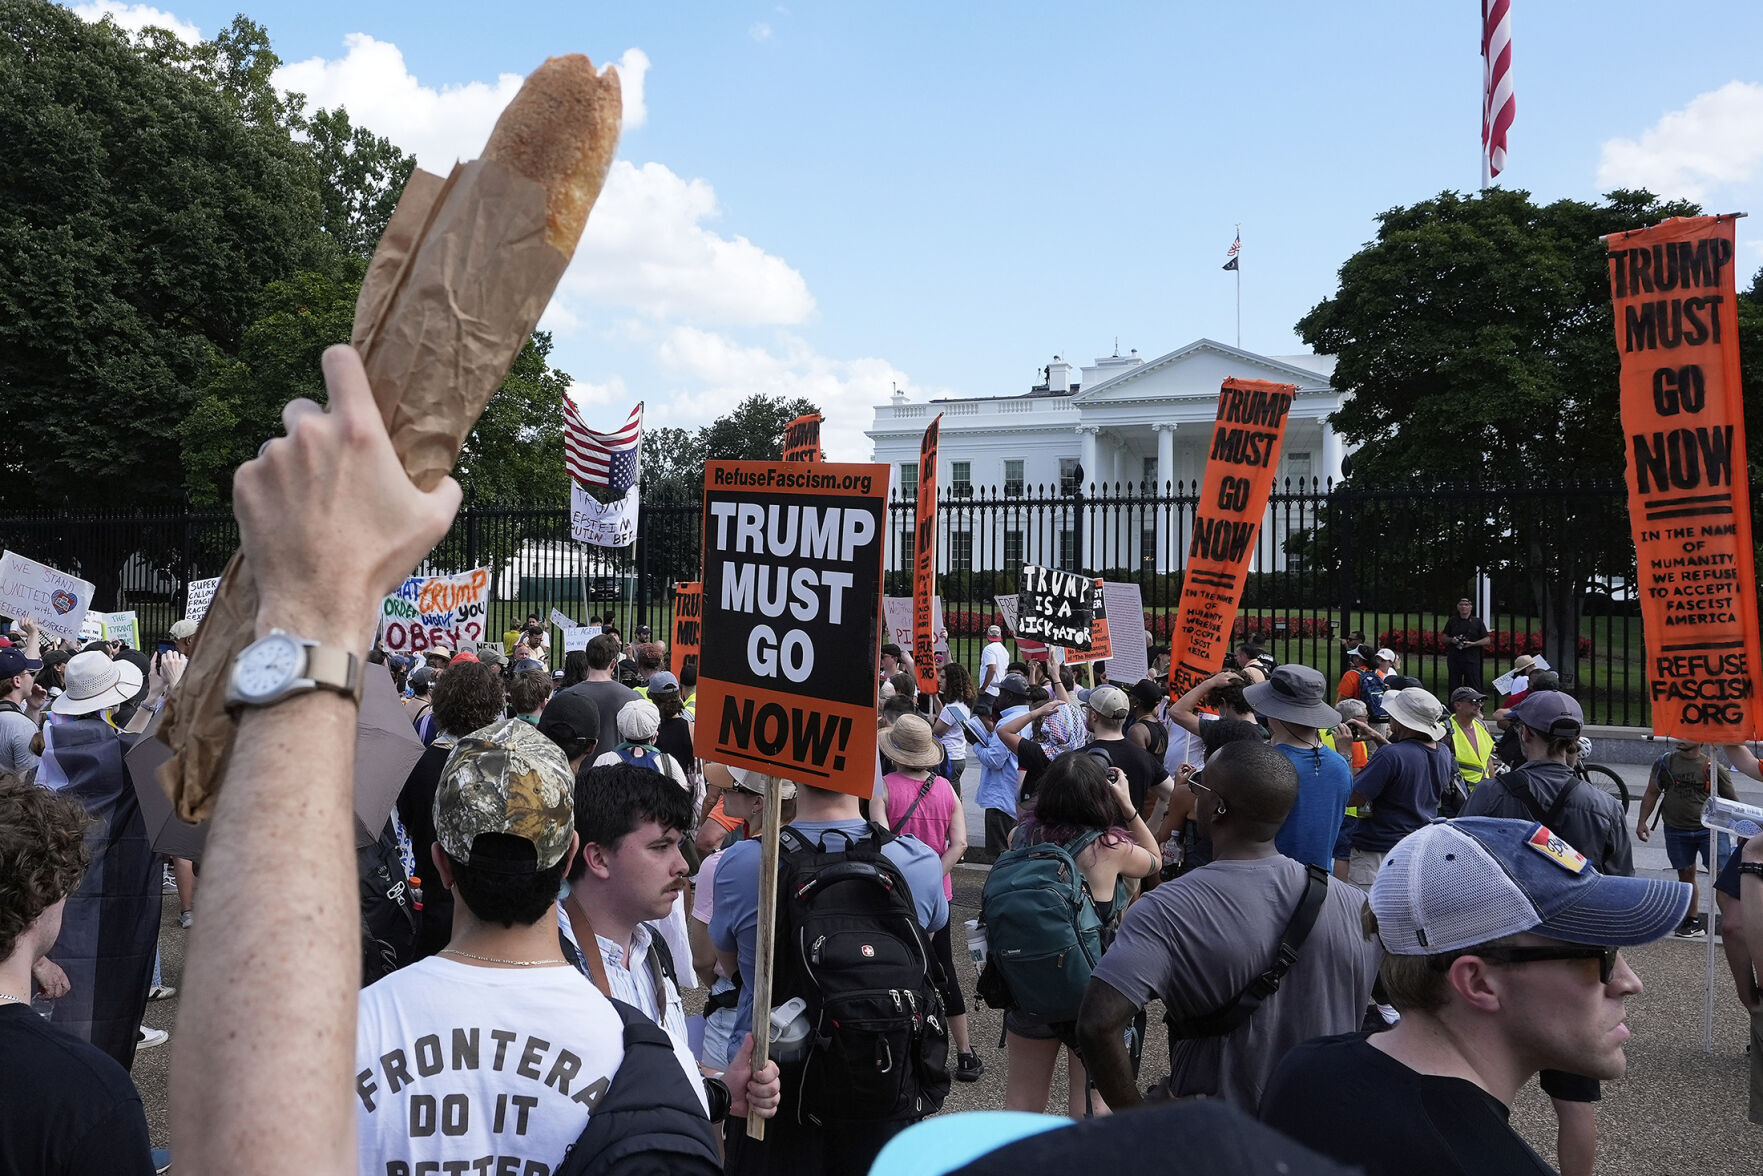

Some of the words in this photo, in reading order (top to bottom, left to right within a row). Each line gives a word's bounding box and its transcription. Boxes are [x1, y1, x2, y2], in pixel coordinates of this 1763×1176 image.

[1609, 237, 1732, 298] TRUMP
[1625, 295, 1723, 353] MUST
[1653, 364, 1705, 416] GO
[1217, 387, 1292, 429] TRUMP
[1211, 427, 1278, 468] MUST
[1632, 424, 1734, 494] NOW
[714, 467, 872, 495] RefuseFascism.org
[1217, 475, 1251, 513] GO
[570, 522, 603, 543] PUTIN
[613, 530, 633, 545] BFF
[711, 501, 876, 562] TRUMP
[1190, 516, 1256, 564] NOW
[1641, 530, 1660, 542] IN
[1665, 527, 1694, 540] THE
[1701, 523, 1737, 537] NAME
[1682, 541, 1705, 553] OF
[1651, 553, 1737, 569] HUMANITY,
[12, 559, 31, 575] WE
[42, 570, 75, 592] STAND
[190, 580, 217, 591] SUPER
[1023, 565, 1090, 604] TRUMP
[1652, 572, 1675, 584] WE
[1681, 567, 1737, 581] REFUSE
[2, 578, 50, 604] UNITED
[721, 561, 854, 624] MUST
[1185, 588, 1197, 597] IN
[1200, 590, 1215, 600] THE
[1648, 587, 1669, 598] TO
[1673, 582, 1733, 596] ACCEPT
[675, 592, 700, 617] TRU
[1035, 595, 1054, 616] IS
[1057, 600, 1072, 618] A
[1204, 602, 1218, 610] OF
[1666, 597, 1733, 611] FASCIST
[1665, 612, 1737, 626] AMERICA
[747, 624, 815, 683] GO
[1656, 653, 1748, 678] REFUSE
[1651, 677, 1754, 701] FASCISM
[1680, 703, 1744, 725] .ORG
[718, 695, 853, 771] NOW!
[356, 1027, 611, 1117] FRONTERA
[409, 1093, 469, 1138] DO
[493, 1093, 538, 1136] IT
